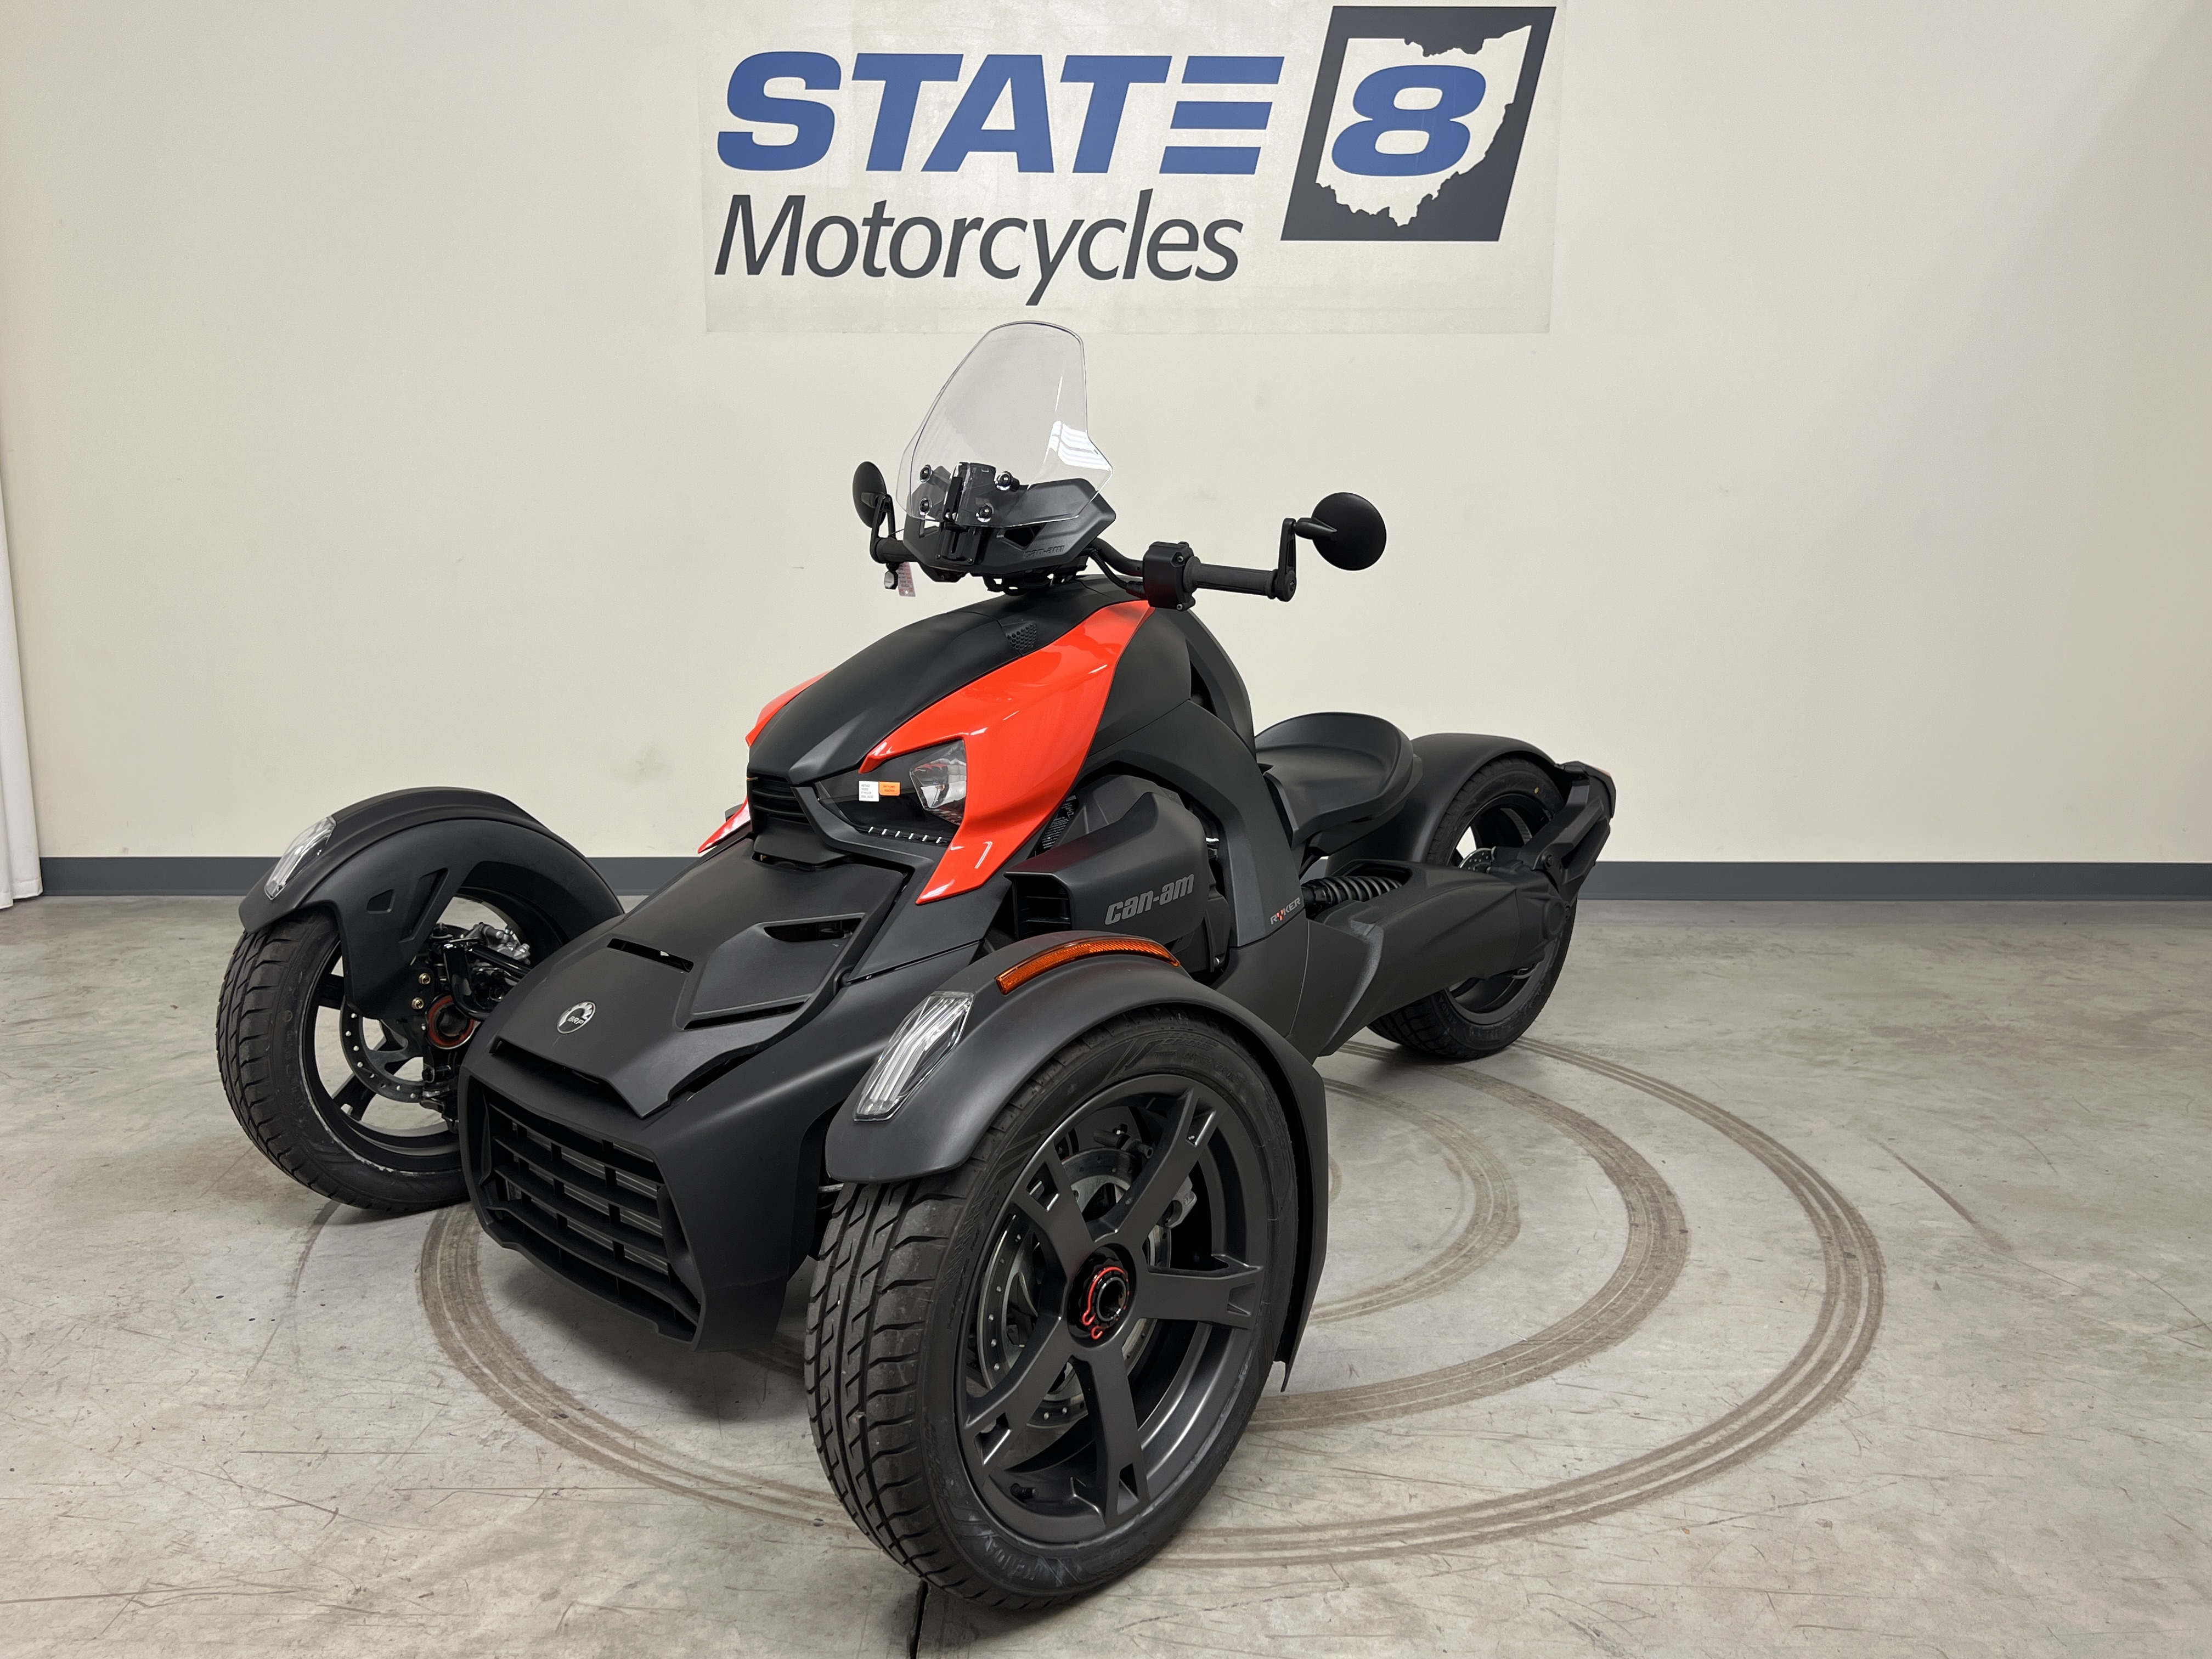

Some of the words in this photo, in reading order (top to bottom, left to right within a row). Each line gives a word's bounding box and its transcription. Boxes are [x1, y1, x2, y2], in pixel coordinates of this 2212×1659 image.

[716, 51, 1285, 174] STATE
[1331, 64, 1487, 177] 8
[714, 189, 1244, 306] Motorcycles
[1104, 873, 1194, 926] can-am
[1269, 896, 1301, 925] RYKER
[567, 1015, 585, 1025] BRP
